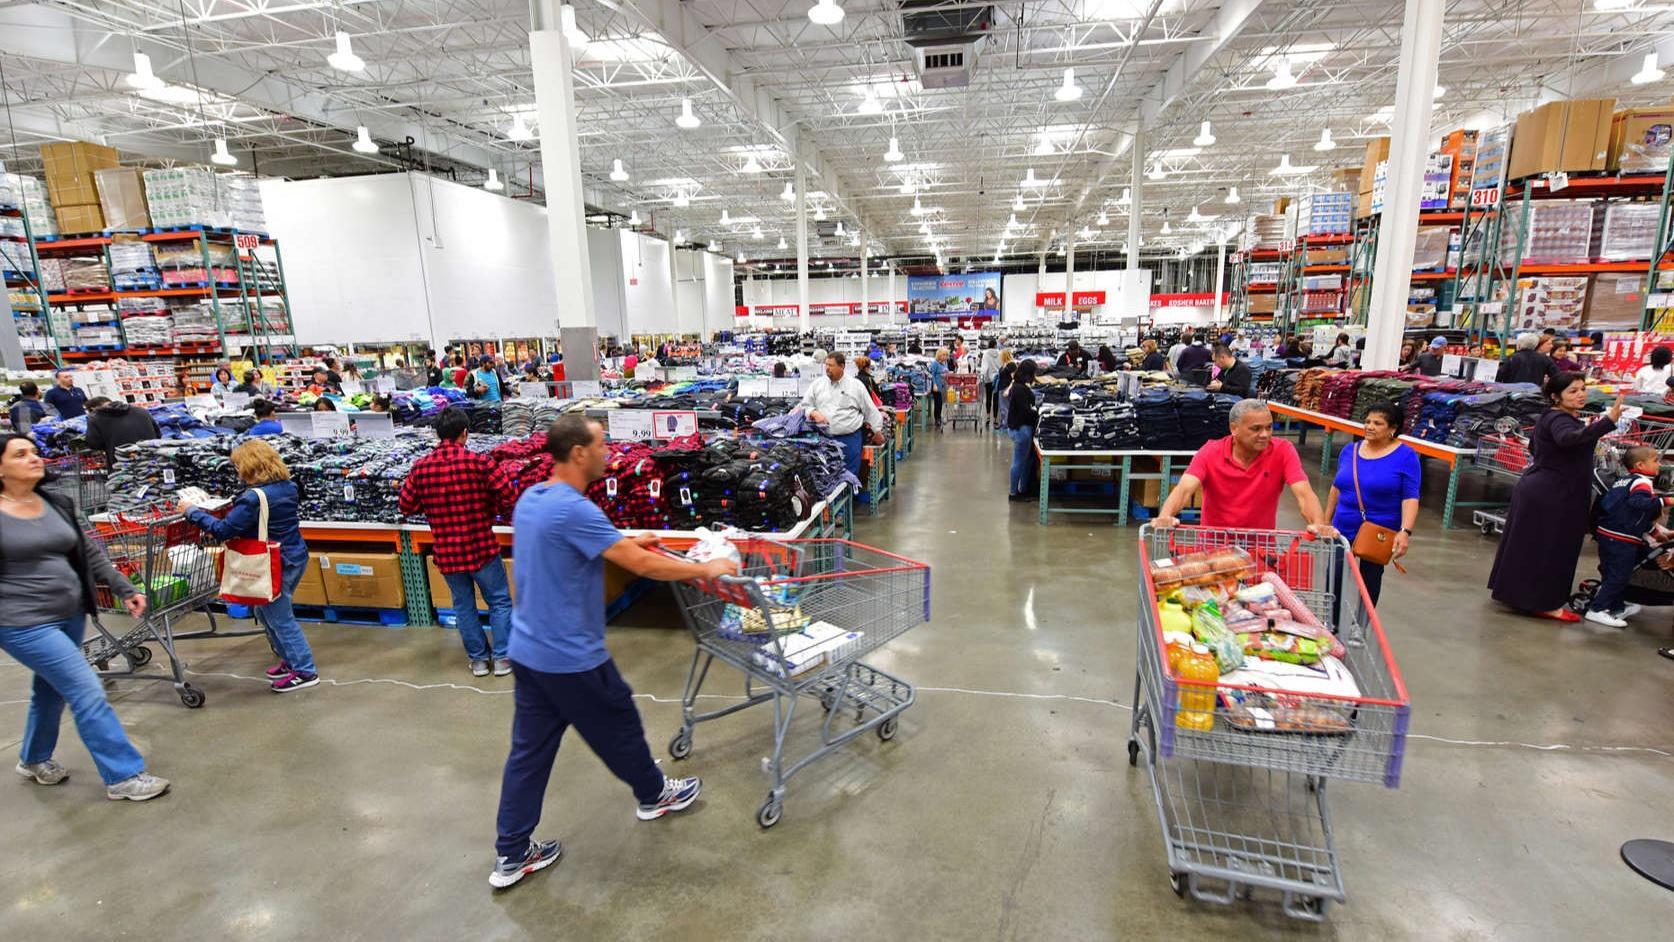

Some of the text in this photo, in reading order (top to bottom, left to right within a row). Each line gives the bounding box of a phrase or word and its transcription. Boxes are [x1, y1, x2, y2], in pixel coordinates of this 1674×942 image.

[1473, 189, 1499, 205] 310
[1279, 240, 1294, 251] 314
[1043, 297, 1063, 306] MILK
[1078, 296, 1098, 305] EGGS
[1168, 299, 1195, 307] KOSHER
[631, 429, 652, 439] 9.99
